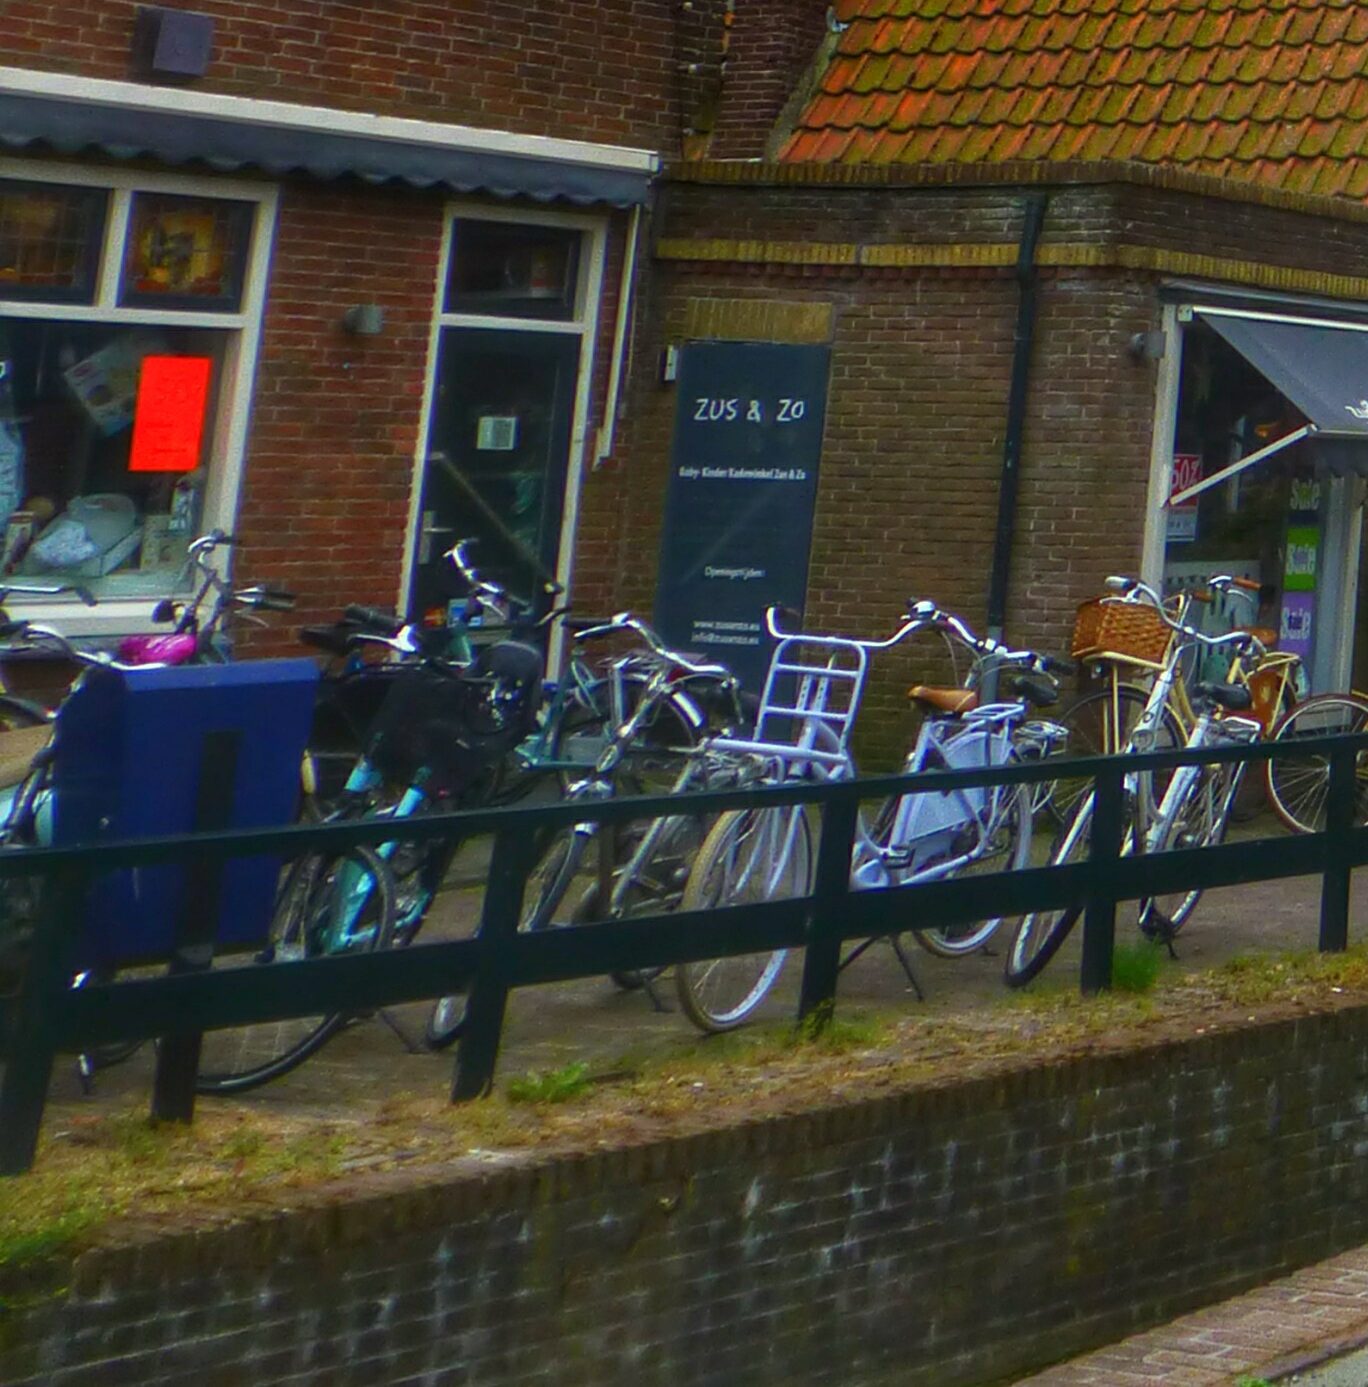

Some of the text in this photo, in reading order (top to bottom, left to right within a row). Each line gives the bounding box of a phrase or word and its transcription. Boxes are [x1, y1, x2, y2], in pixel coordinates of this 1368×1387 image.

[693, 397, 805, 423] ZUS & ZO
